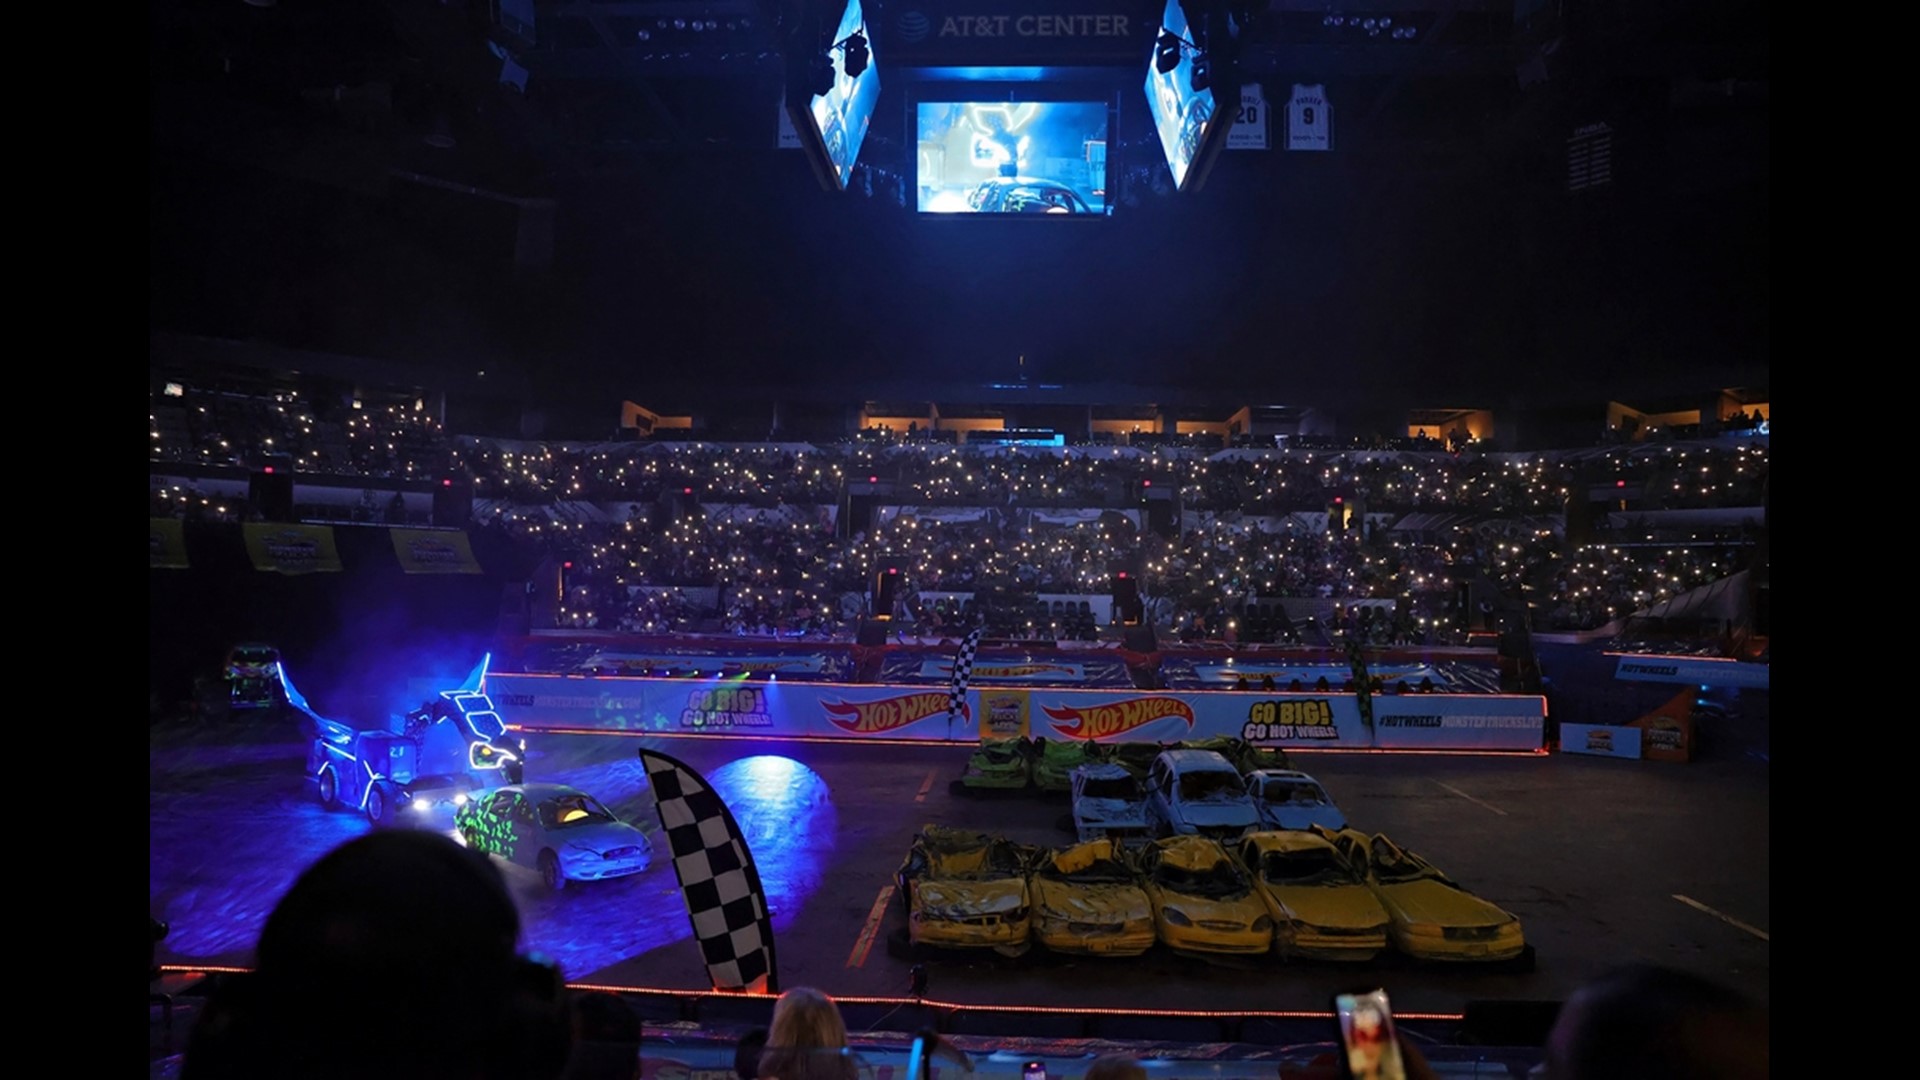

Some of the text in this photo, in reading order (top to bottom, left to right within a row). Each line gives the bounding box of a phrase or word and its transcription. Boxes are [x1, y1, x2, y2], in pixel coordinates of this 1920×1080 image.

[938, 15, 1130, 37] AT&T CENTER
[1235, 106, 1257, 124] 20
[1303, 107, 1314, 124] 9
[688, 689, 765, 713] GO BIG!
[681, 709, 704, 726] GO
[705, 711, 731, 725] HOT
[855, 694, 951, 731] HOT WHEE
[1077, 699, 1187, 736] HOT WHEELS
[1251, 700, 1331, 726] GO BIG!
[1243, 722, 1338, 740] GO HOT WHEELS
